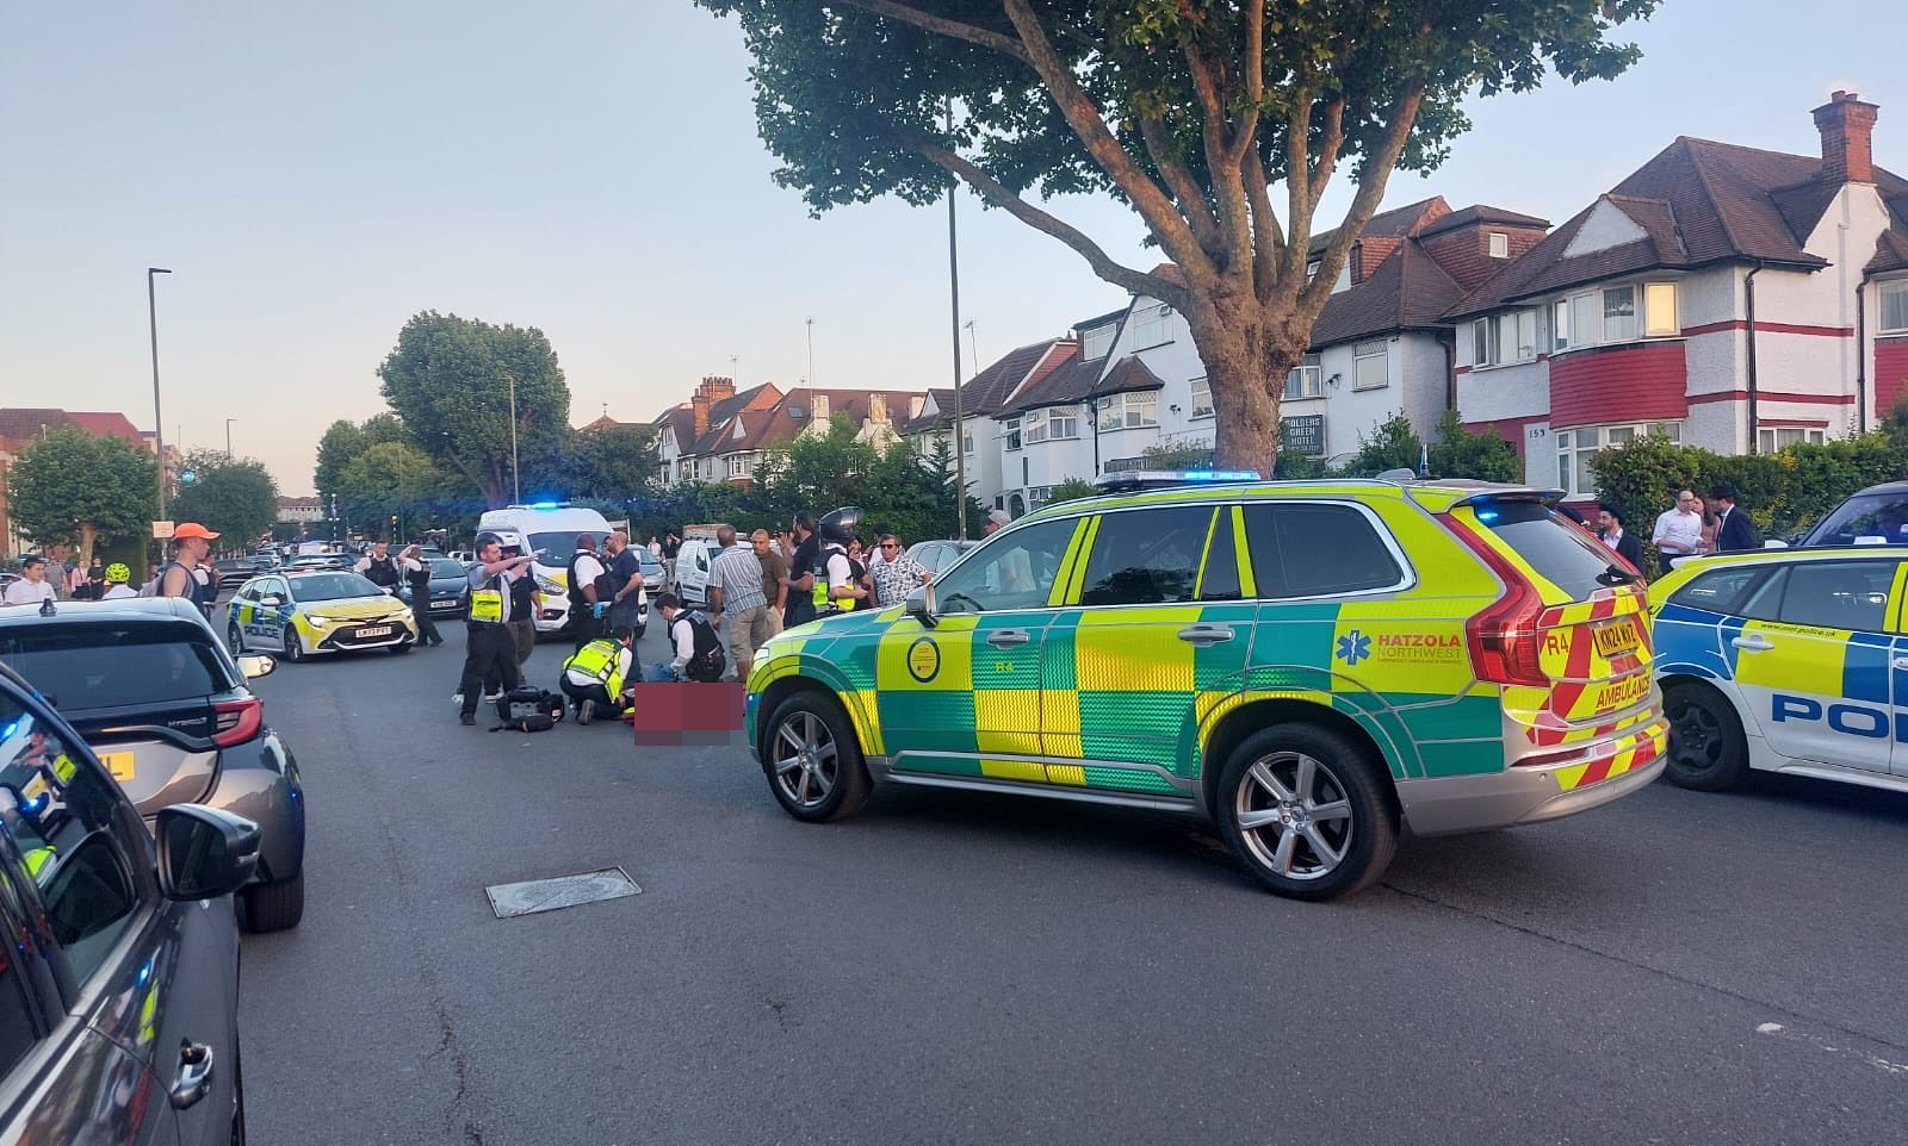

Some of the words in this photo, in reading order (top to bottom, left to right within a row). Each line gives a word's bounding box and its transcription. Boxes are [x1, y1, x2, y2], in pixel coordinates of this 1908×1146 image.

[1289, 427, 1315, 436] GREEN
[1291, 436, 1313, 445] HOTEL
[244, 625, 280, 639] POLICE
[1378, 634, 1462, 647] HATZOLA
[1545, 633, 1569, 656] R4
[1377, 647, 1462, 659] NORTHWEST
[995, 660, 1014, 673] R4
